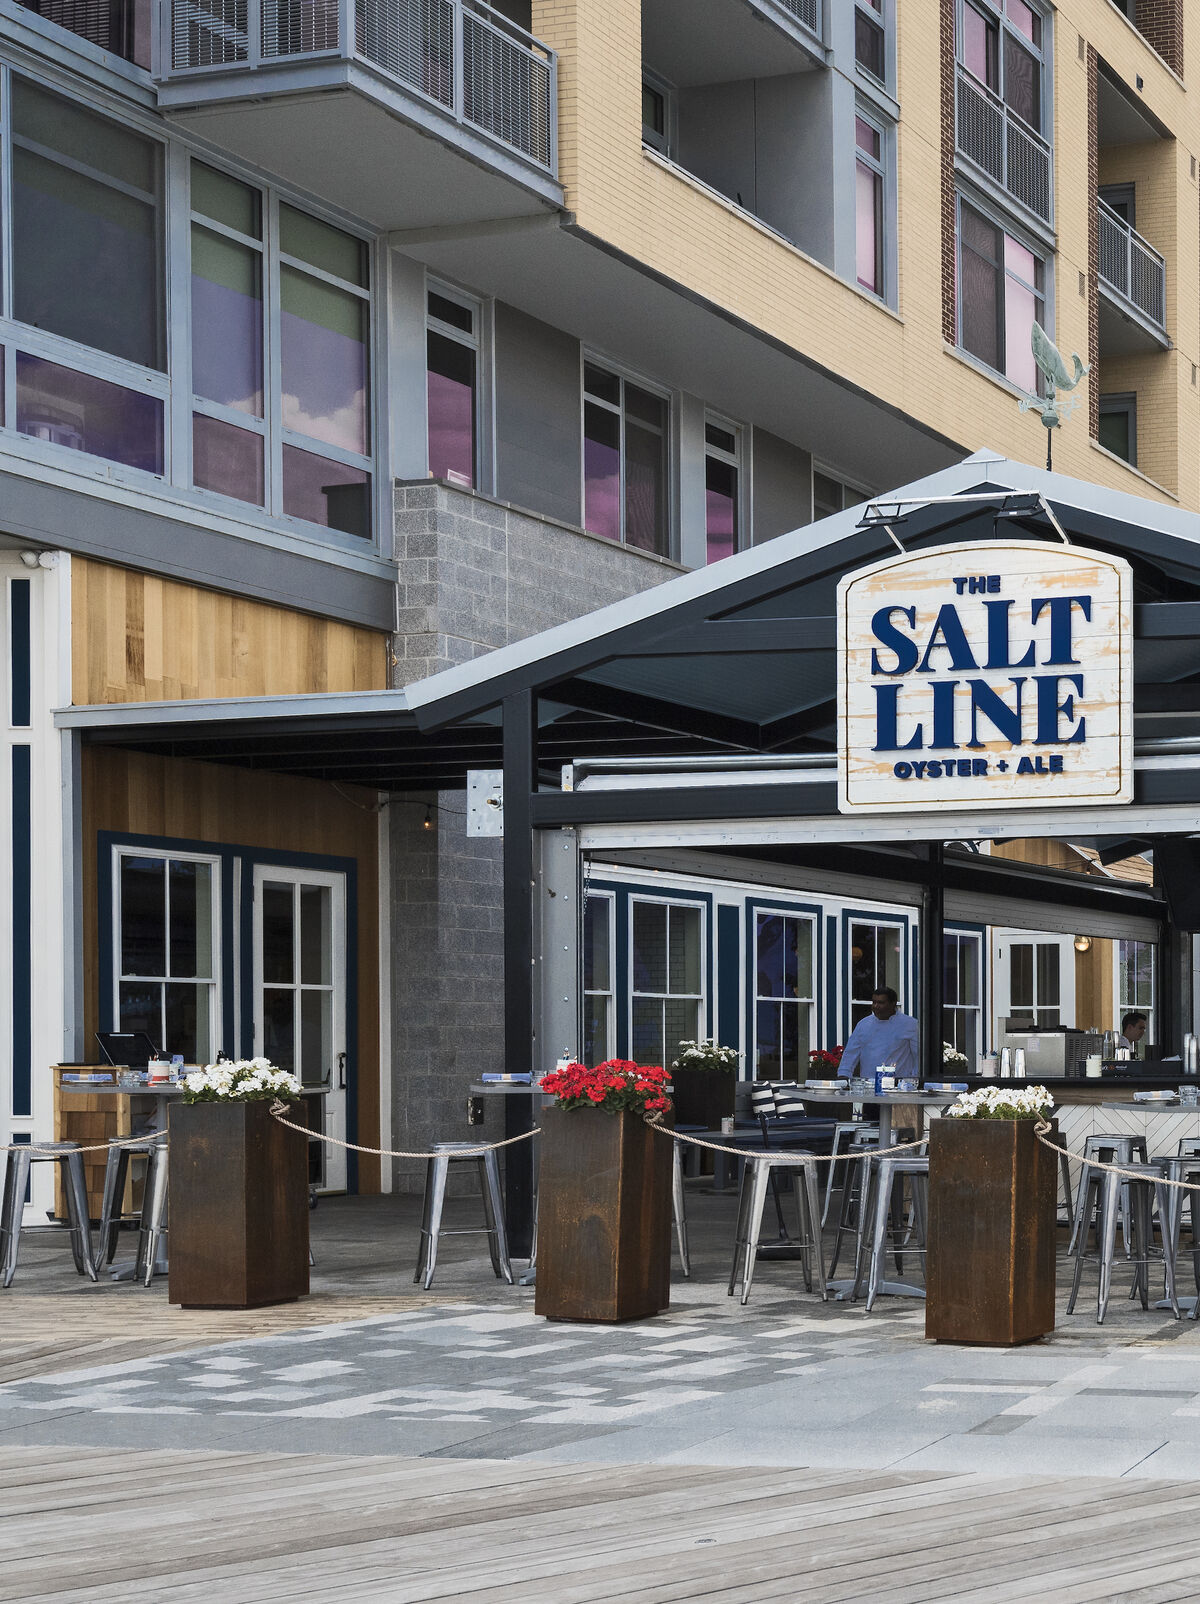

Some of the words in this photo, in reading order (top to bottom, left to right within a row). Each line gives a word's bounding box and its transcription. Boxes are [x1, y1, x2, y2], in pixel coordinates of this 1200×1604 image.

[952, 575, 1001, 595] THE
[871, 595, 1092, 676] SALT
[871, 673, 1086, 752] LINE
[893, 758, 988, 780] OYSTER
[1016, 755, 1064, 775] ALE
